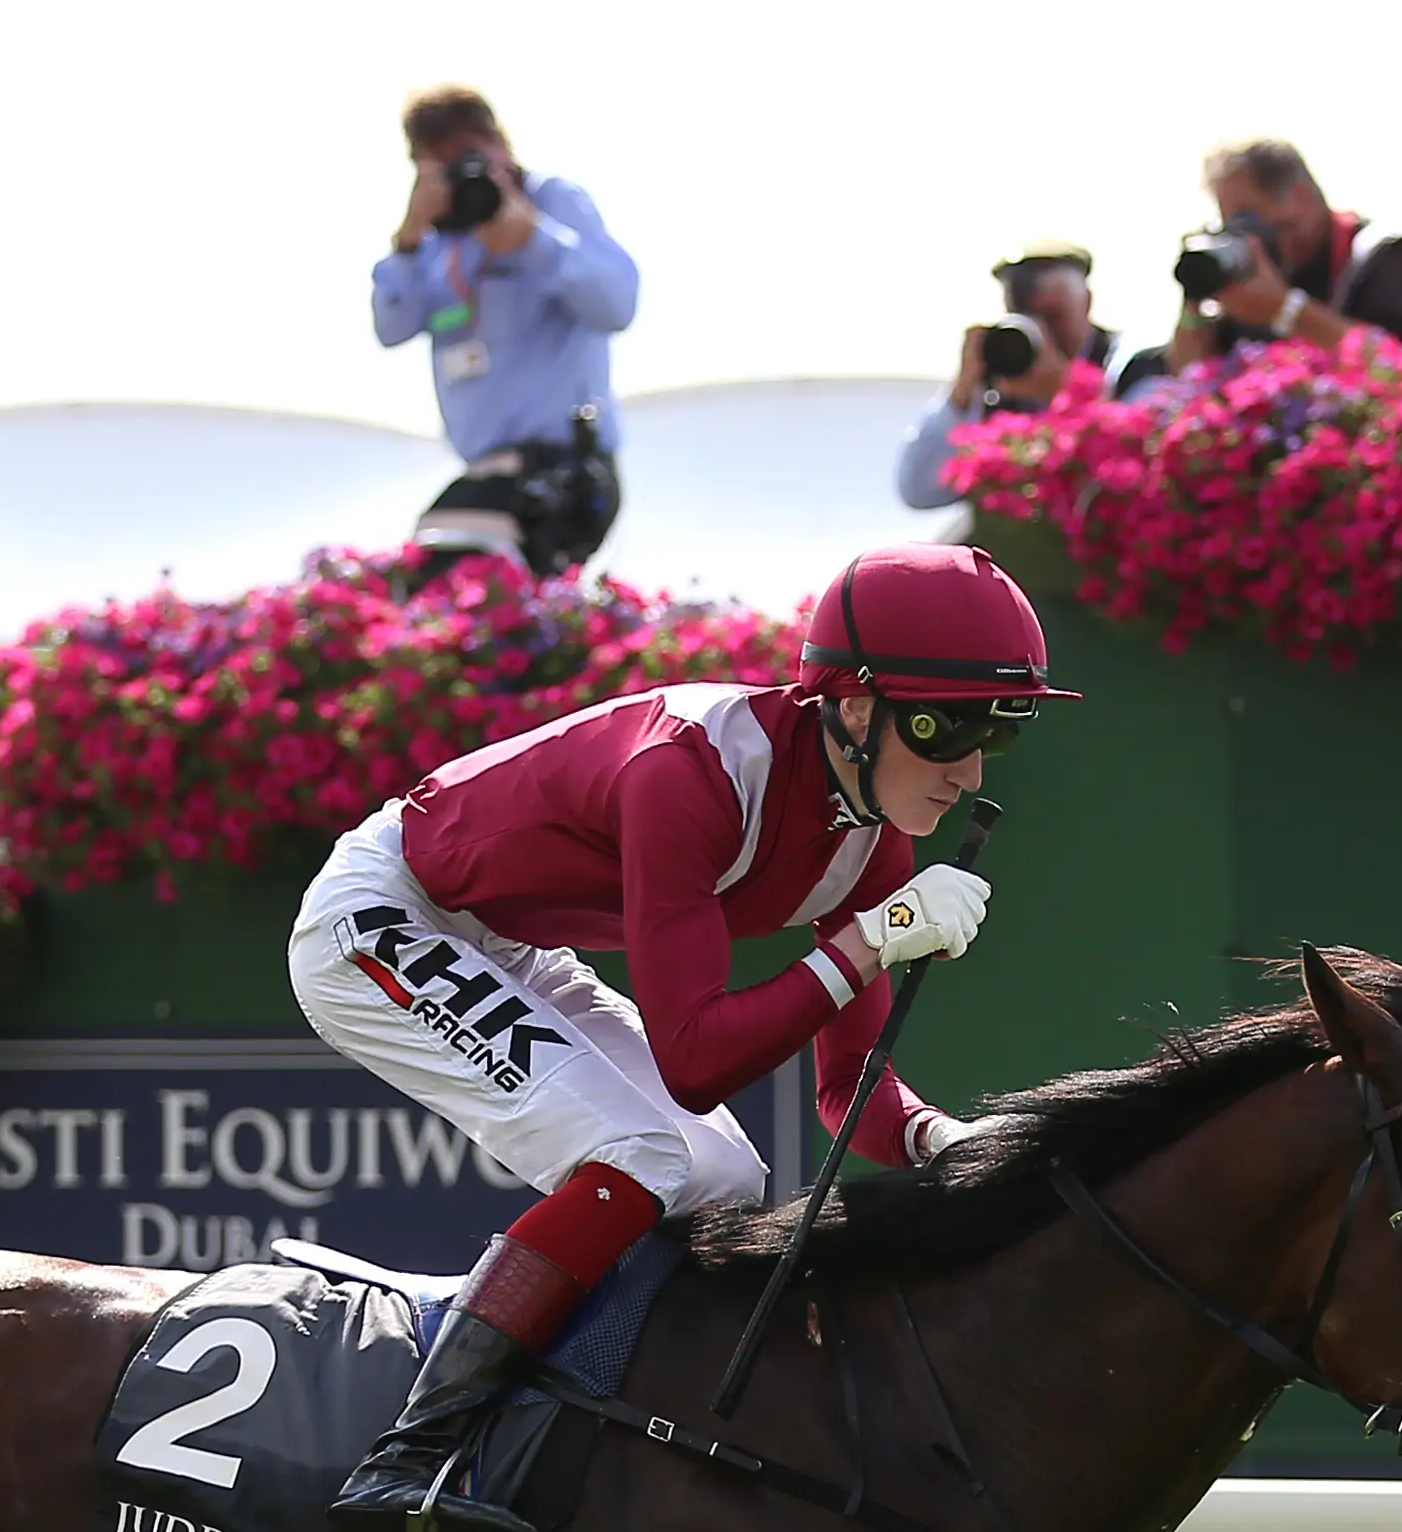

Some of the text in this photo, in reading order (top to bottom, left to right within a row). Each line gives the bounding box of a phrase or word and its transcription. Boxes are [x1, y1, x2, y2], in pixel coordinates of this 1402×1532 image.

[353, 905, 573, 1078] KHK
[412, 998, 526, 1094] RACING
[116, 1318, 276, 1489] 2
